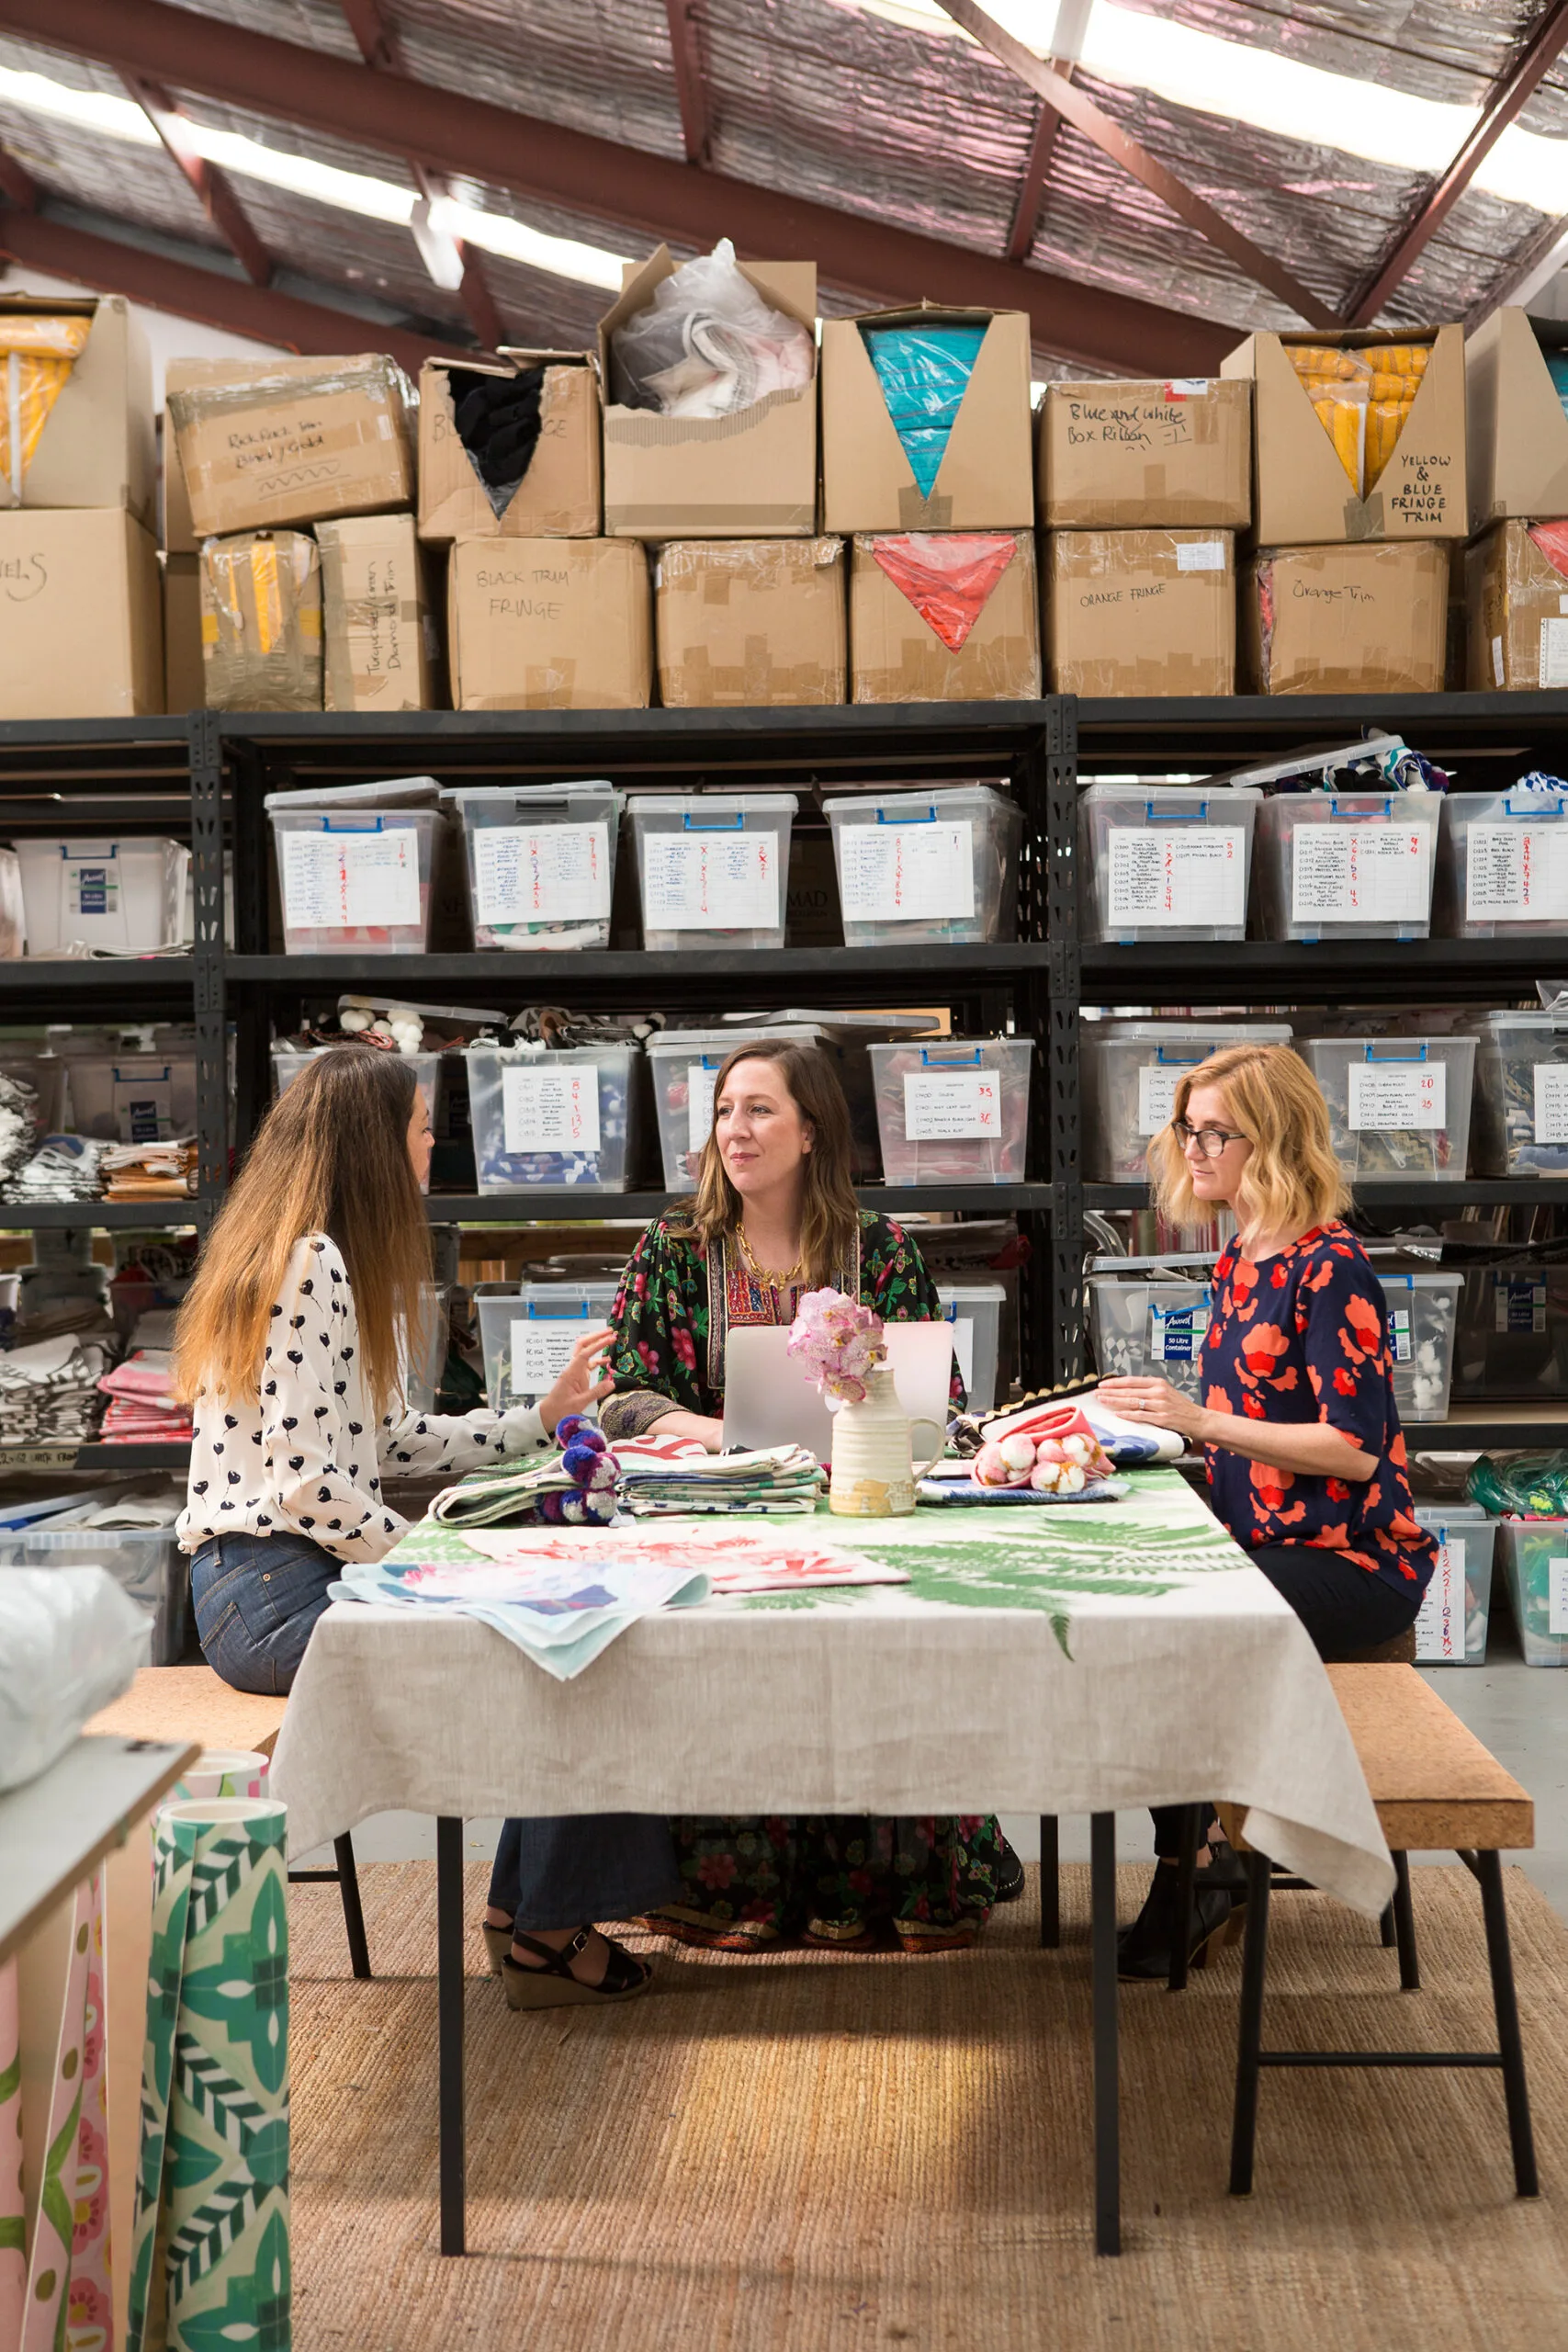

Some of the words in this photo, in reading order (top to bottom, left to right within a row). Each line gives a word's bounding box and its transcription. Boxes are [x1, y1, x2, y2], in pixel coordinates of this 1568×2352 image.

[1069, 403, 1109, 421] Blue
[1068, 426, 1096, 445] Box
[1102, 424, 1152, 446] Ribbon
[1402, 455, 1451, 467] YELLOW
[1416, 466, 1429, 481] &
[1404, 483, 1442, 496] BLUE
[1392, 497, 1447, 509] FRINGE
[1402, 512, 1442, 523] TRIM
[477, 571, 525, 588] BLACK
[532, 570, 570, 586] TRIM
[1080, 591, 1122, 607] ORANGE
[1130, 582, 1167, 601] FRINGE
[1293, 579, 1342, 604] Orange
[1343, 586, 1375, 603] Trim
[489, 598, 564, 620] FRINGE
[1421, 1079, 1434, 1089] 20
[1165, 1314, 1192, 1330] Award
